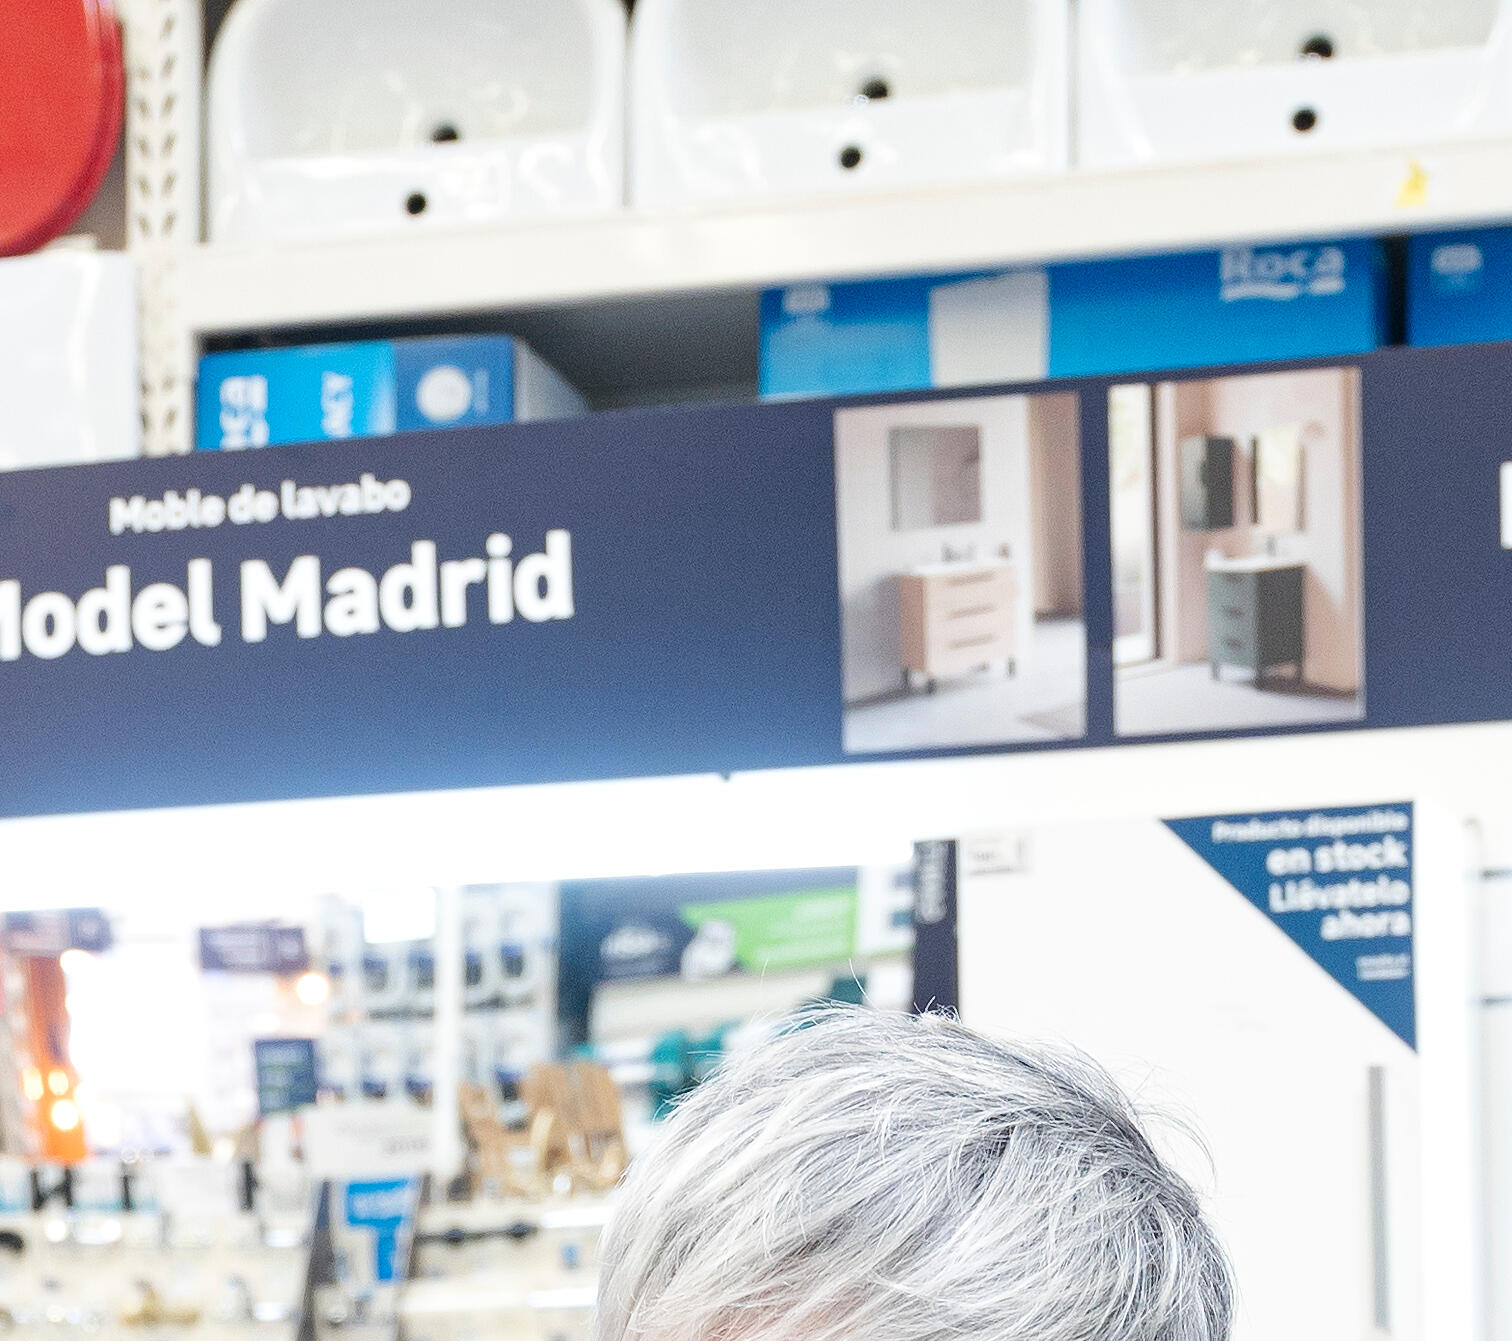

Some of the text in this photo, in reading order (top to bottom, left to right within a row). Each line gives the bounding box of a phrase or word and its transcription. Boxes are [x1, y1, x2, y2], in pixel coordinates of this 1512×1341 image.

[110, 474, 412, 536] Moble de lavabo
[240, 530, 575, 644] Madrid
[1266, 838, 1408, 877] en stock
[1269, 875, 1411, 913] Llévatelo
[1321, 909, 1411, 941] ahora
